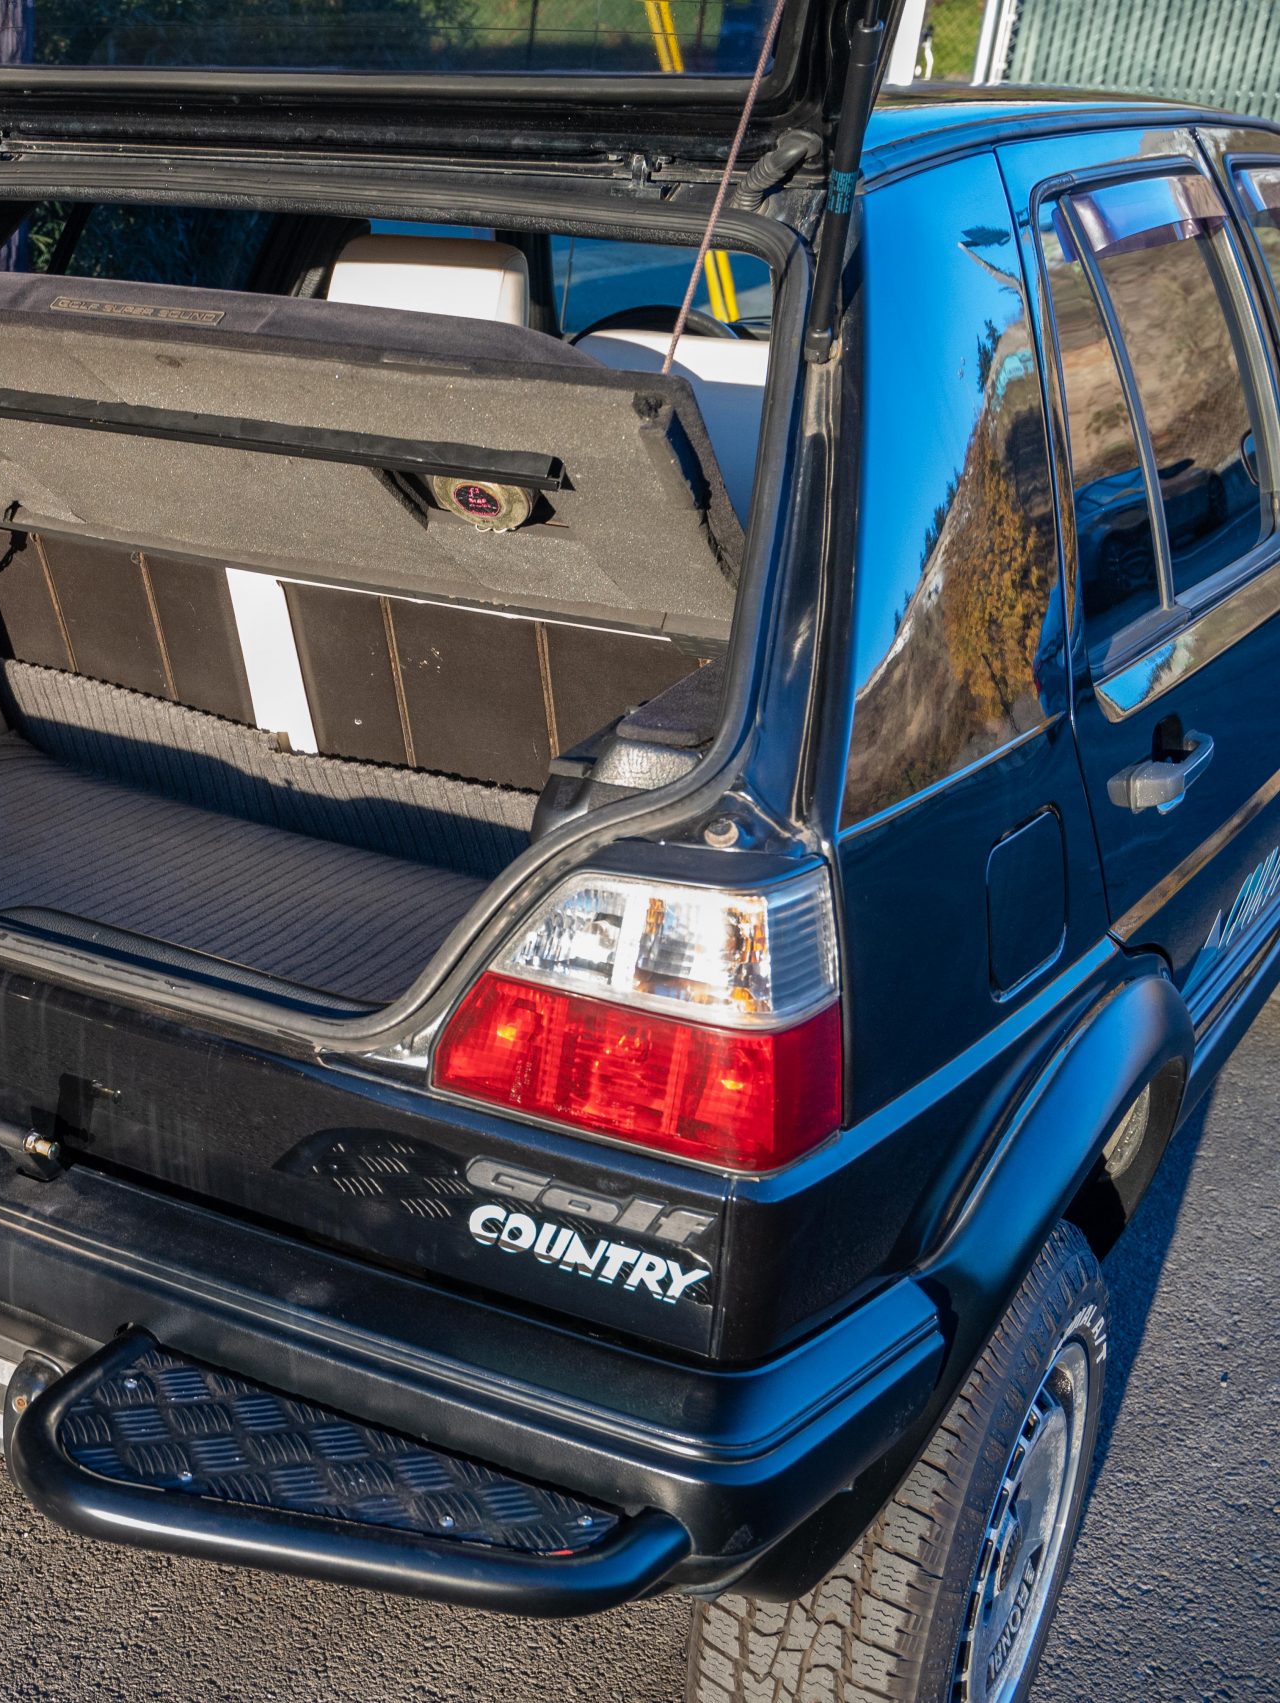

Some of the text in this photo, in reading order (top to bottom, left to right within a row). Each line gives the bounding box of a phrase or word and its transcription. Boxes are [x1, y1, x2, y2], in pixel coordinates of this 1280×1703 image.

[57, 299, 216, 321] GOLF SUPER SOUND
[468, 1204, 710, 1304] COUNTRY
